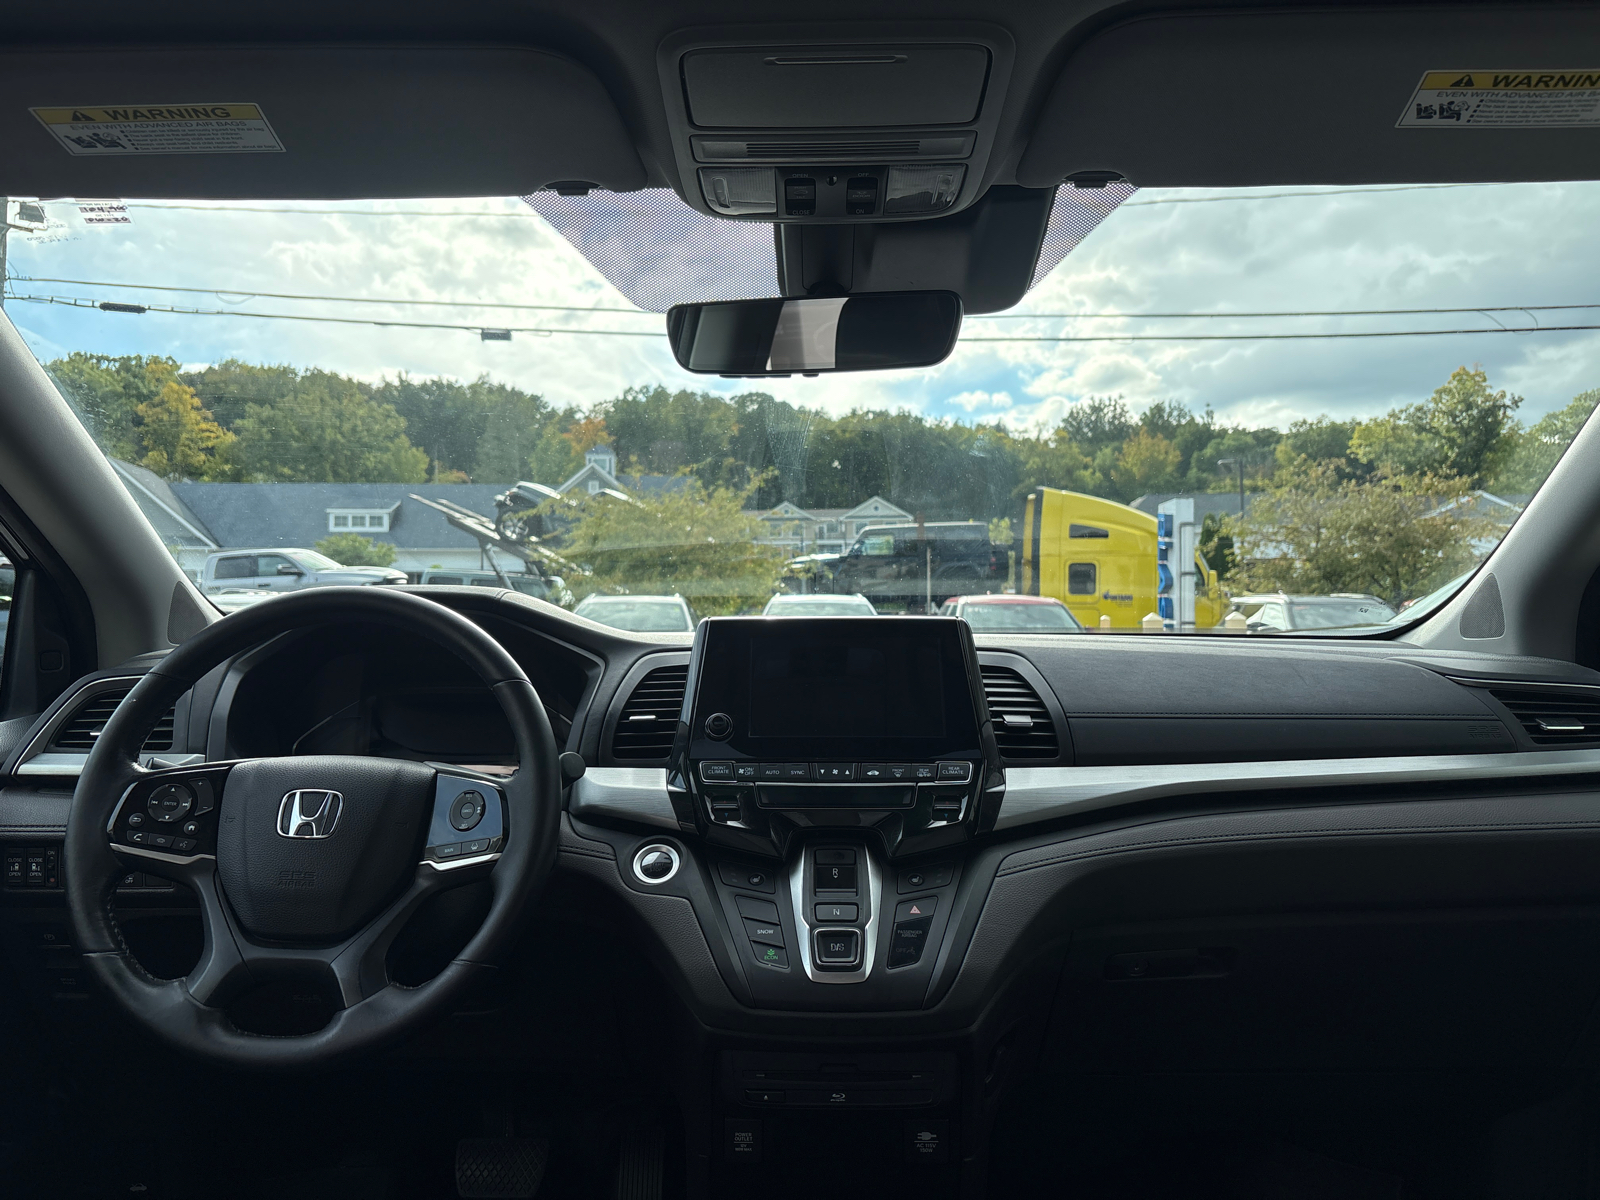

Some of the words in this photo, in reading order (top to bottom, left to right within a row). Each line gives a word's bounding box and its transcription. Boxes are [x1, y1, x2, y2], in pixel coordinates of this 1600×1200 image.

[103, 107, 231, 121] WARNING
[134, 121, 193, 129] ADVANCED
[832, 868, 839, 876] R
[830, 943, 845, 951] D/S
